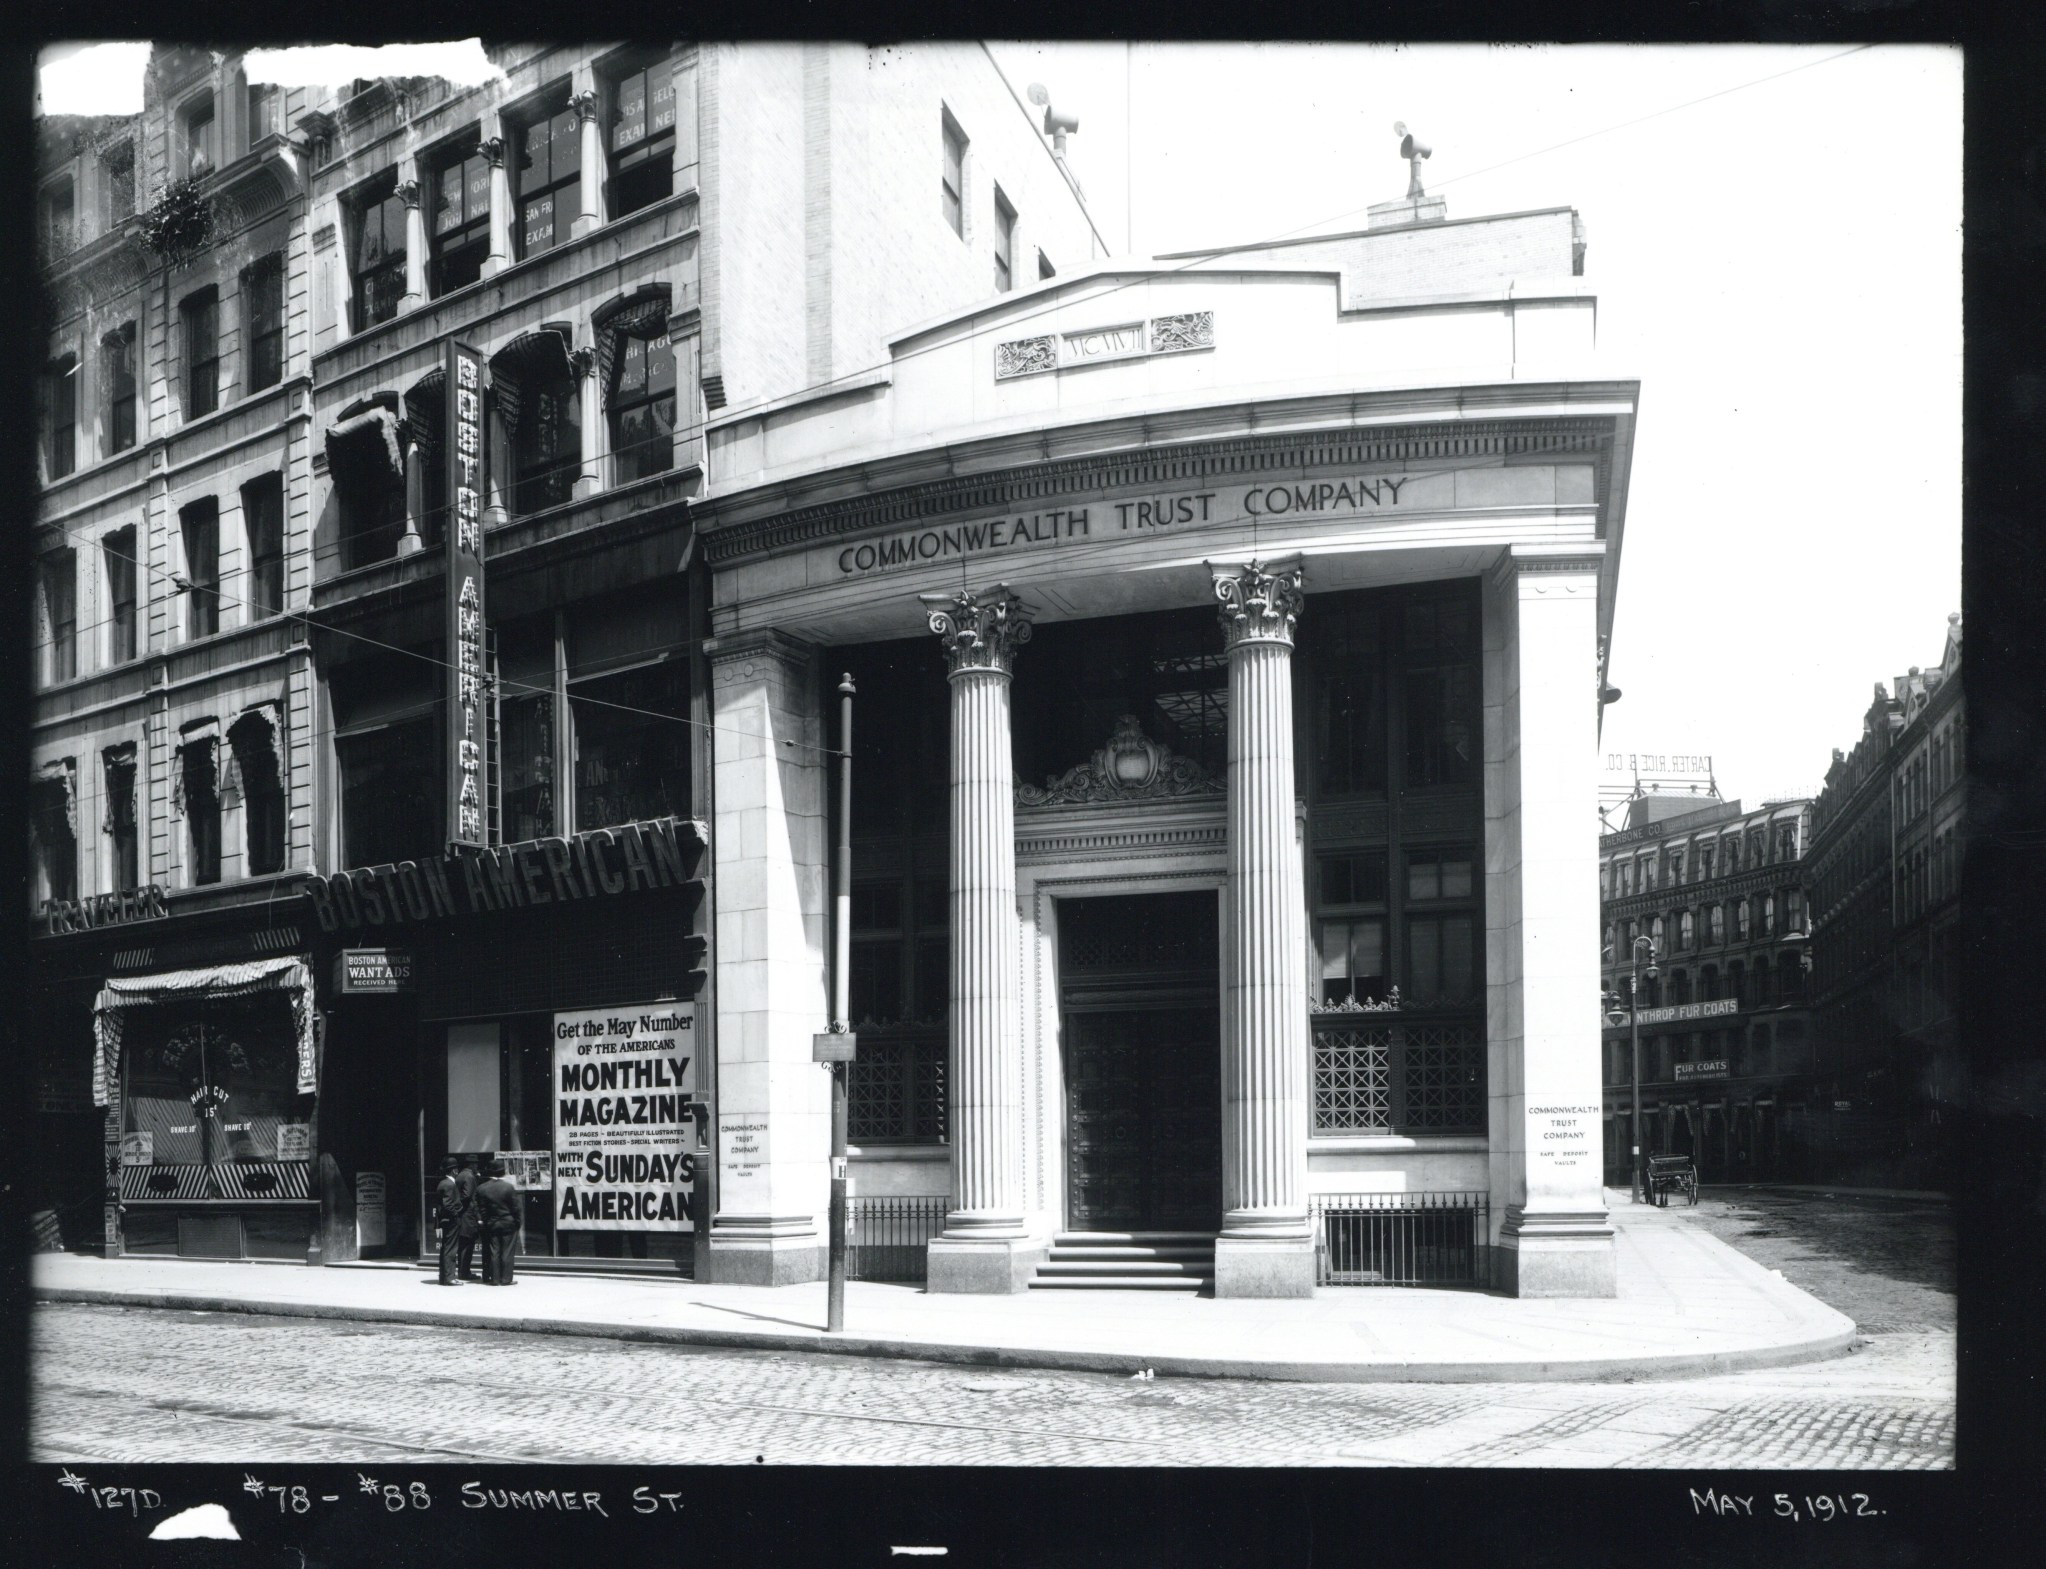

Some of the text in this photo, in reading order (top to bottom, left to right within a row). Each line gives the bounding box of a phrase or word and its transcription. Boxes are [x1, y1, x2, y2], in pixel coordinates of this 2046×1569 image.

[838, 477, 1407, 574] COMMONWEALTH TRUST COMPANY
[457, 354, 480, 840] BOSTON AMERICAN
[307, 818, 687, 933] BOSTON AMERICAN
[40, 884, 169, 934] TRAVELER
[348, 955, 411, 965] BOSTON AMERICAN
[348, 966, 410, 979] WANT ADS
[1627, 1000, 1737, 1024] NTHROP FUR COATS
[557, 1013, 694, 1039] Get the May Number
[577, 1045, 592, 1055] OF
[595, 1043, 617, 1054] THE
[561, 1057, 690, 1093] MONTHLY
[1675, 1061, 1727, 1081] FUR COATS
[190, 1085, 230, 1105] HAIR CUT
[559, 1094, 693, 1126] MAGAZINE
[1528, 1106, 1599, 1115] COMMONWEALTH
[224, 1123, 242, 1132] SHAVE
[721, 1124, 768, 1133] COMMONWEALTH
[1551, 1119, 1577, 1127] TRUST
[735, 1135, 753, 1143] TRUST
[1543, 1131, 1586, 1140] COMPANY
[557, 1152, 584, 1163] WITH
[731, 1146, 759, 1154] COMPANY
[557, 1167, 583, 1177] NEXT
[586, 1150, 694, 1183] SUNDAY'S
[559, 1186, 694, 1221] AMERICAN
